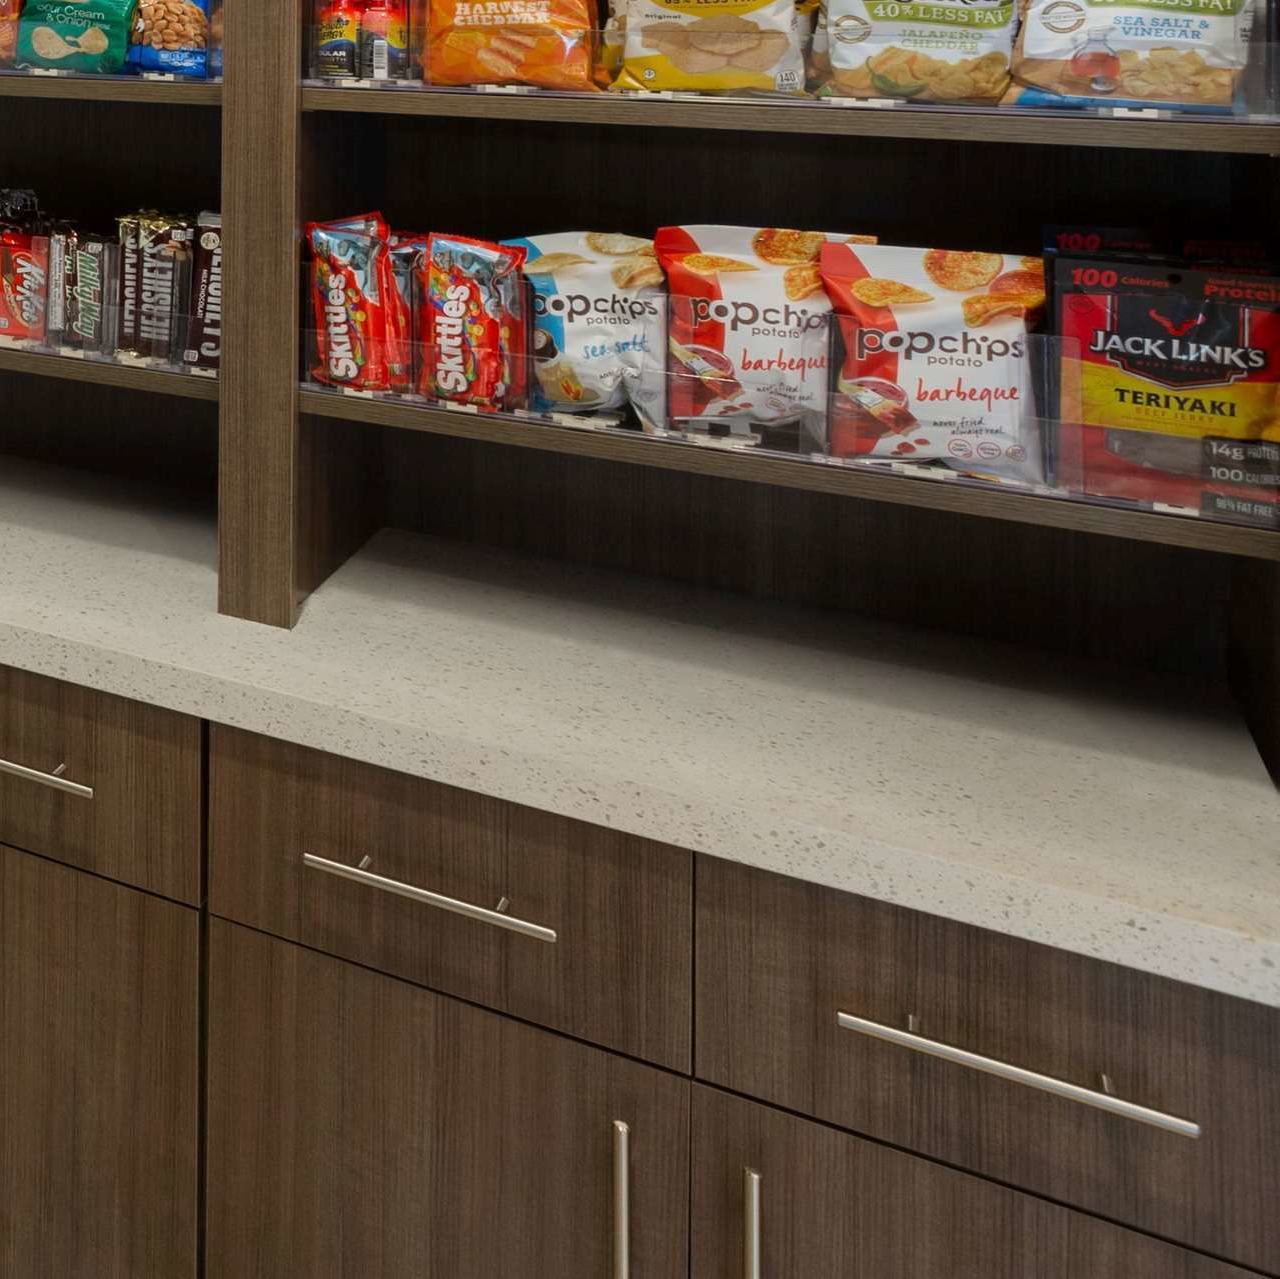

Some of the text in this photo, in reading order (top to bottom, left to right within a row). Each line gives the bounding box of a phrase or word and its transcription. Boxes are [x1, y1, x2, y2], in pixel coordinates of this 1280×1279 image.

[64, 5, 105, 20] Cream
[455, 0, 551, 14] HARVEST
[873, 4, 1007, 24] 40% LESS FAT
[46, 13, 92, 28] & Onion
[453, 13, 551, 26] CHEDDAR
[1113, 16, 1210, 30] SEA SALT &
[899, 25, 984, 40] JALAPEÑO
[1121, 27, 1202, 40] VINEGAR
[901, 39, 978, 51] CHEDDAR
[778, 72, 796, 83] 140
[1072, 267, 1170, 289] 100 calories
[73, 250, 101, 338] Milky Way
[141, 243, 173, 341] HERSHEY'S
[324, 273, 359, 380] Skittles
[586, 312, 631, 326] potato
[436, 283, 471, 394] Skittles
[751, 326, 801, 339] potato
[1090, 330, 1265, 369] JACK LINK'S
[741, 348, 829, 383] barbeque
[927, 355, 984, 369] potato
[915, 377, 1021, 412] barbeque
[1115, 388, 1237, 417] TERIYAKI
[1210, 441, 1245, 461] 14g
[1211, 466, 1244, 481] 100
